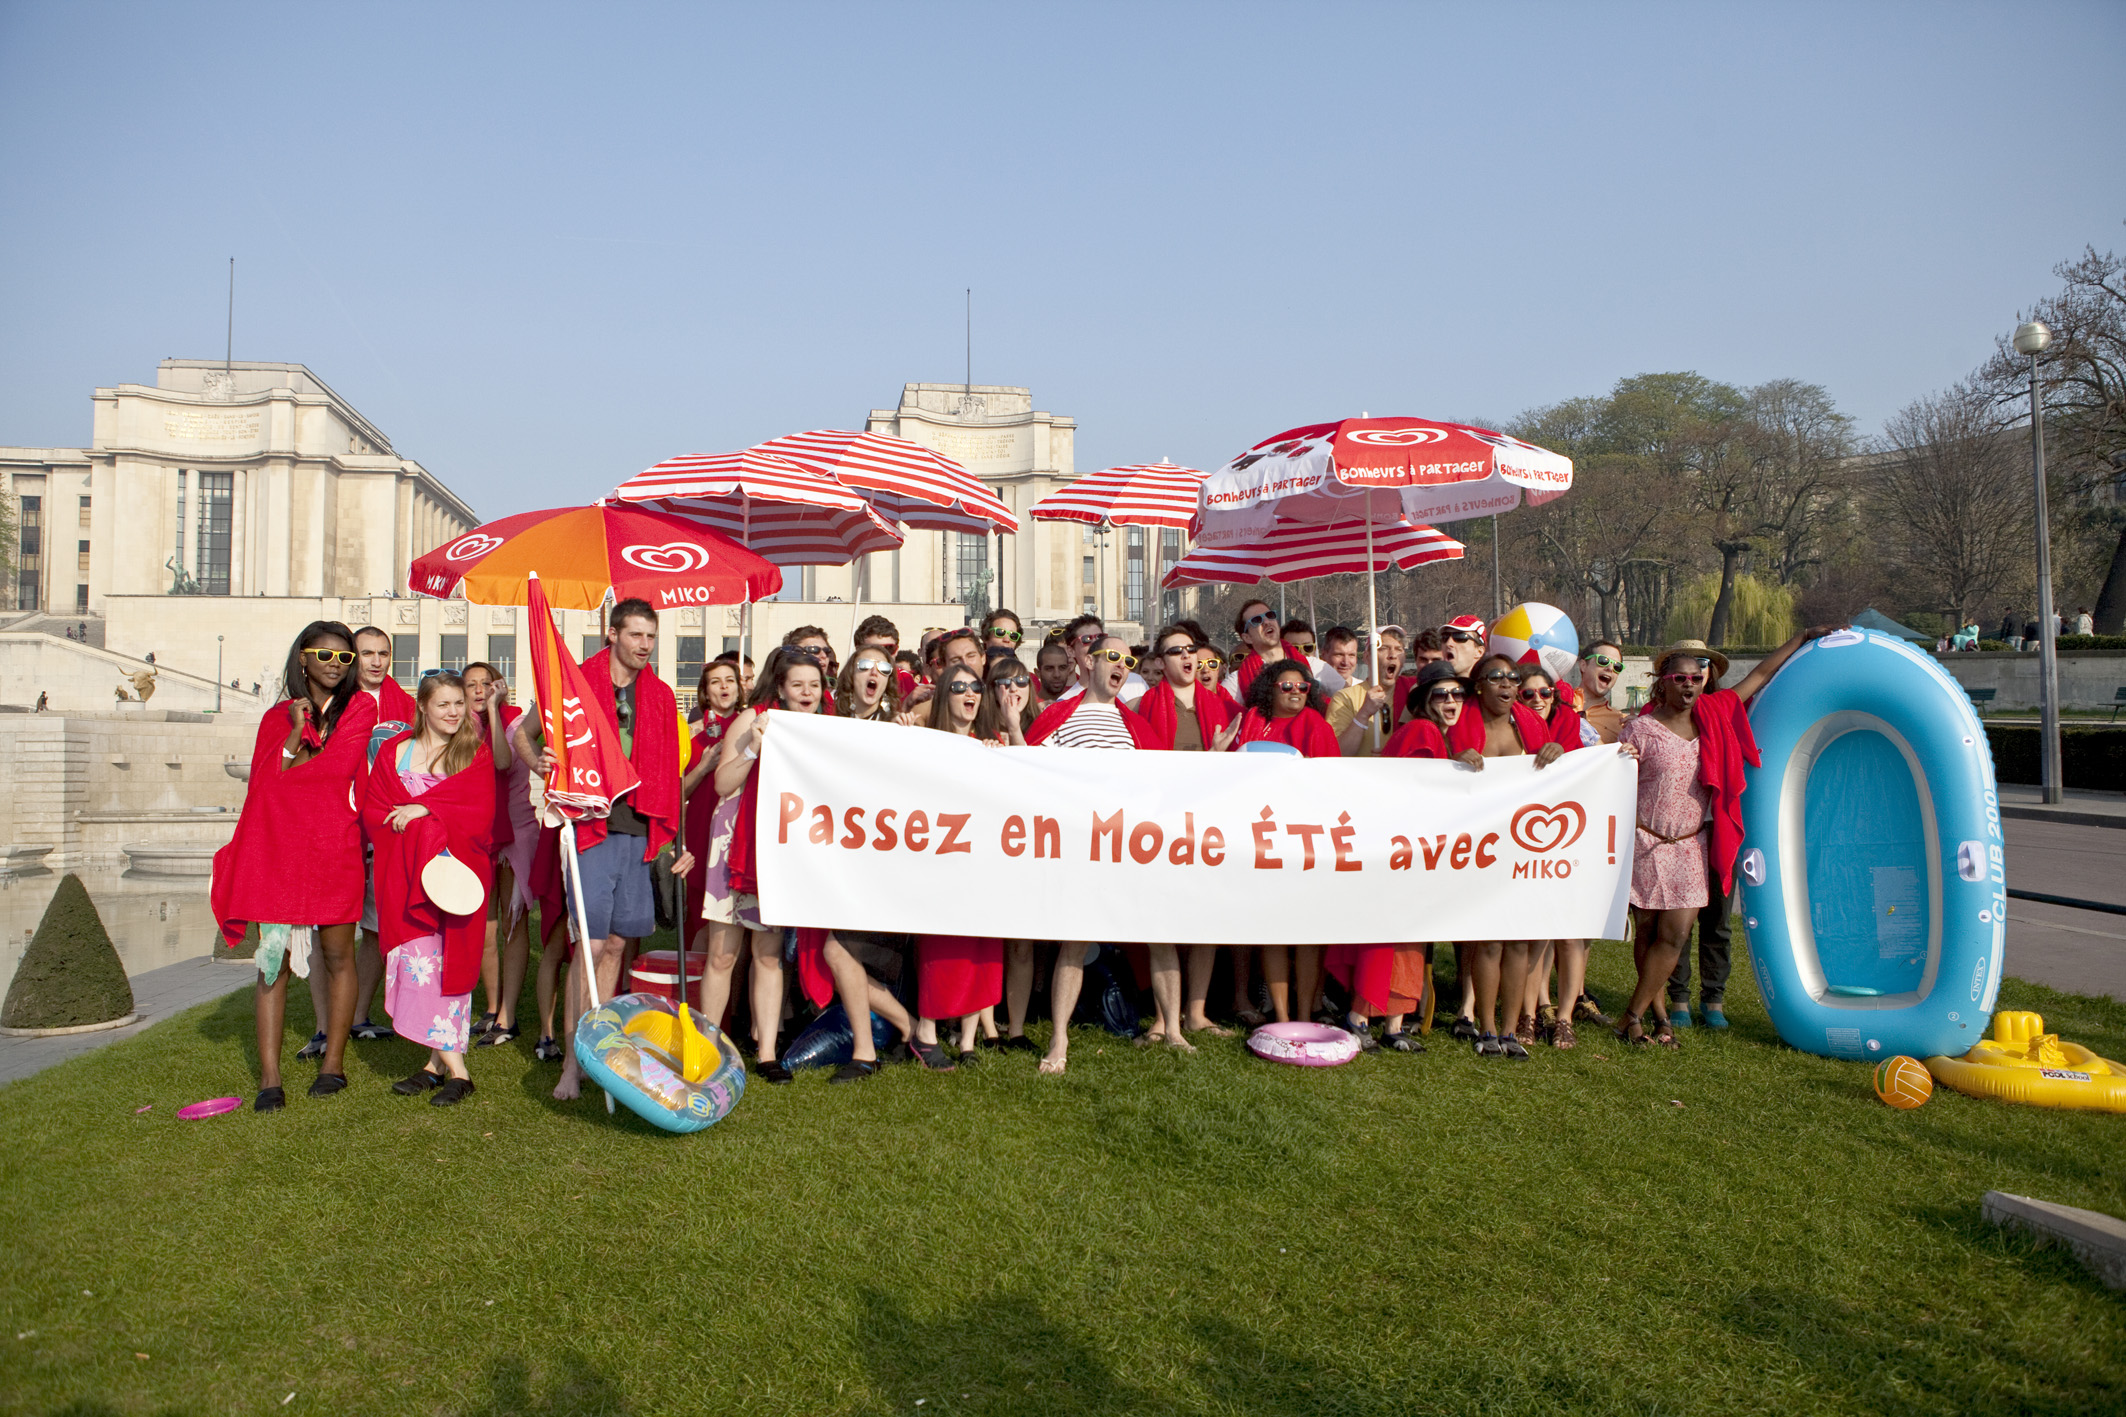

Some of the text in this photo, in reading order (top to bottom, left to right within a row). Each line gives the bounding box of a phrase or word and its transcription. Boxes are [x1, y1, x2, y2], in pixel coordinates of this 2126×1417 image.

[778, 792, 1617, 872] Passez en Mode ÉTÉ avec !
[1983, 789, 2006, 922] CLUB 200
[1972, 964, 1985, 992] INTEX
[2042, 1071, 2066, 1079] POOL
